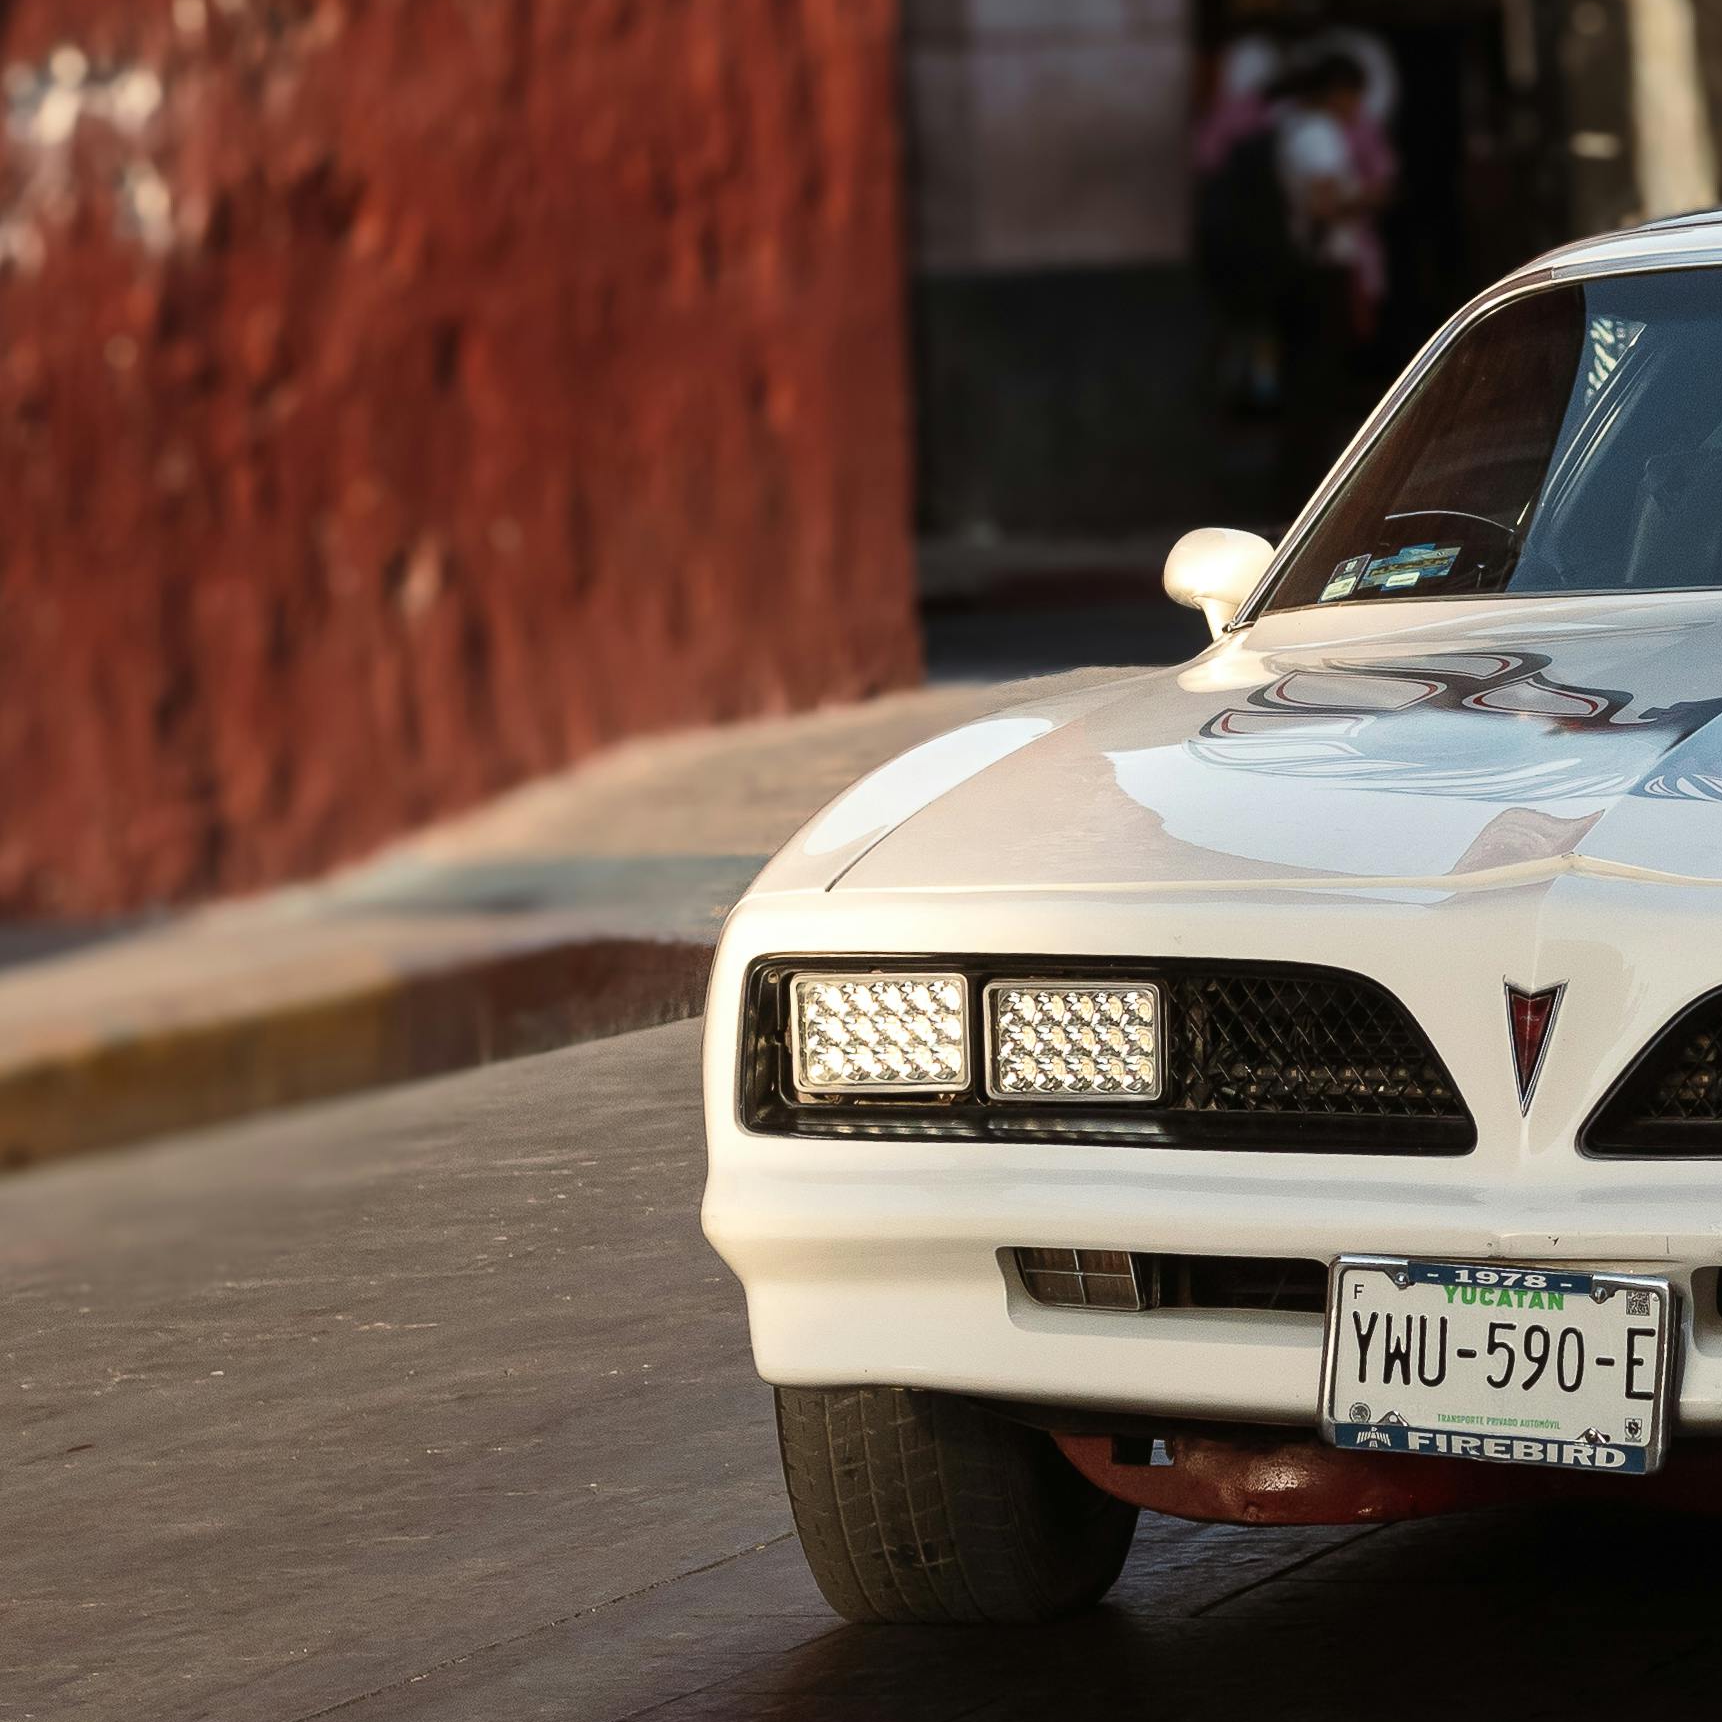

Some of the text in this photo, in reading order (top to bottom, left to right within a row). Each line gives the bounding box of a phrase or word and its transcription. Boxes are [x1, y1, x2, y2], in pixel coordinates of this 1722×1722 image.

[1454, 1269, 1548, 1289] 1978
[1353, 1284, 1365, 1300] F
[1442, 1284, 1564, 1311] YUCATAN
[1352, 1310, 1656, 1401] YWU-590-E
[1437, 1413, 1561, 1431] TRANSPORTE PRIVADO AUTOMÓVIL
[1407, 1431, 1627, 1469] FIREBIRD
